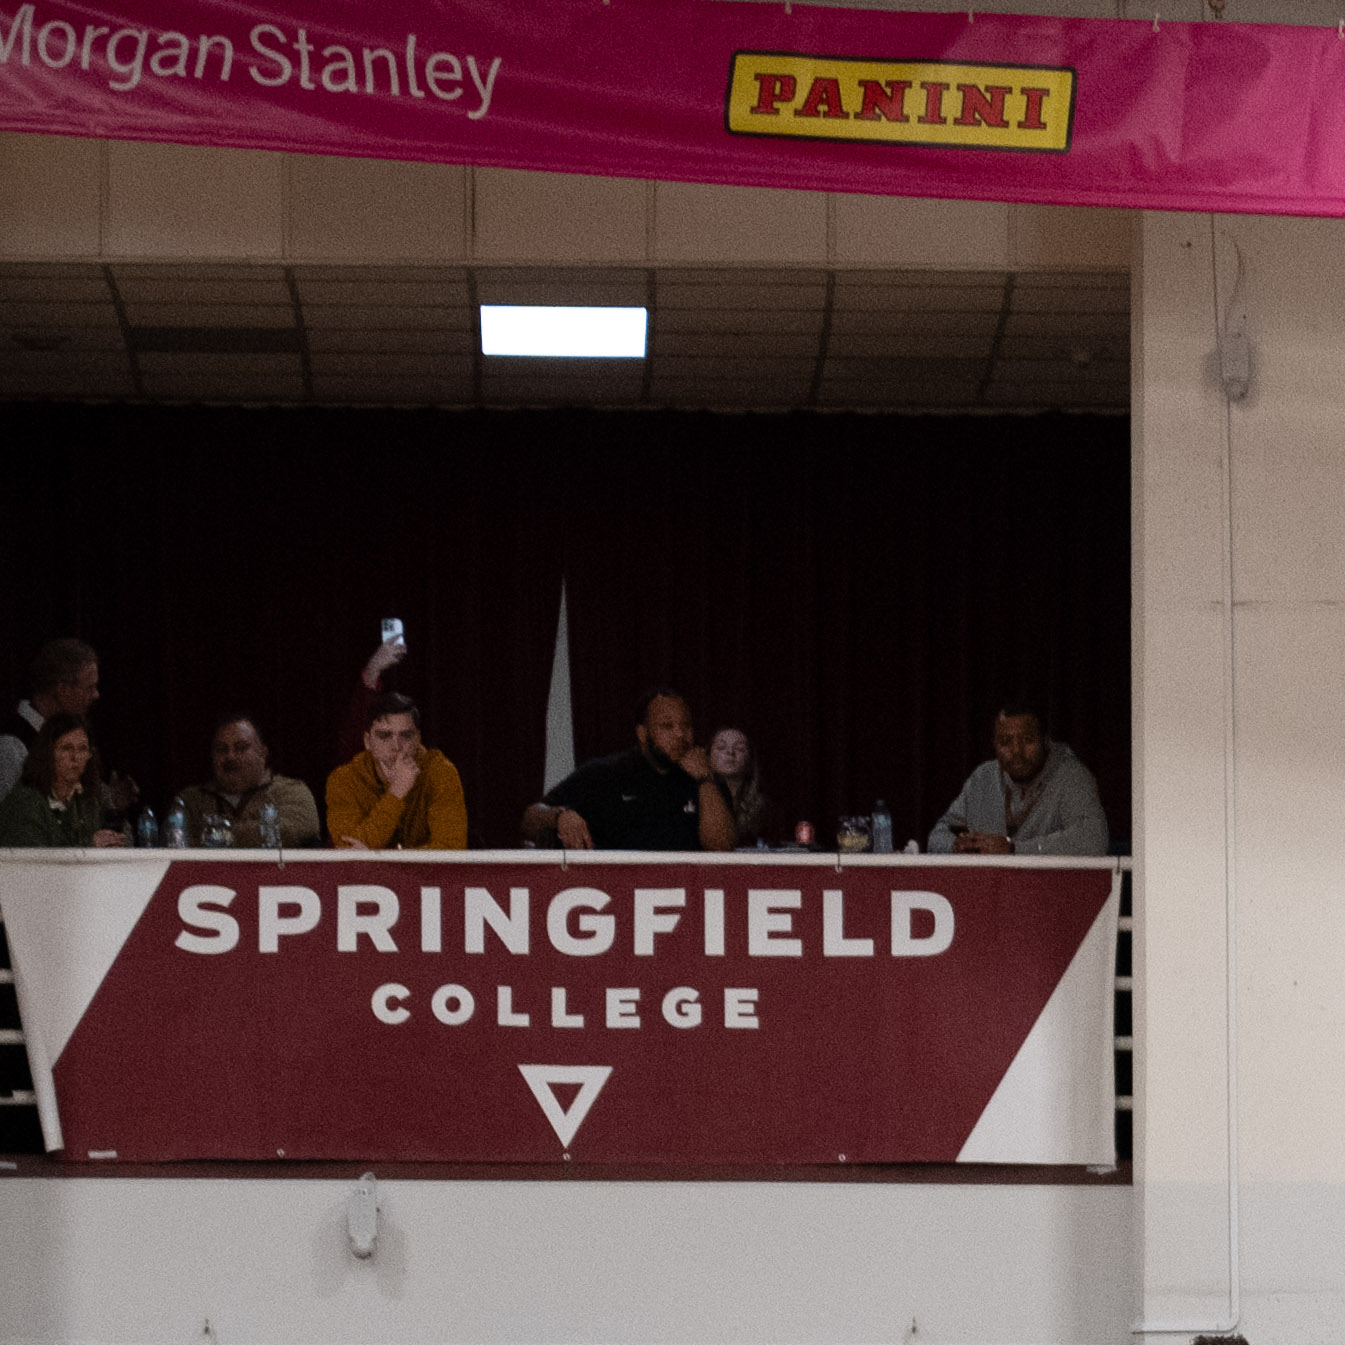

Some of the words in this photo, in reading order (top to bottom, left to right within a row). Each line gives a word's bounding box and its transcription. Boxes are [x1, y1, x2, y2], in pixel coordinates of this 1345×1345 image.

[0, 2, 233, 92] Morgan
[248, 24, 503, 120] Stanley
[749, 71, 1052, 131] PANINI
[174, 883, 956, 958] SPRINGFIELD
[370, 982, 761, 1030] COLLEGE
